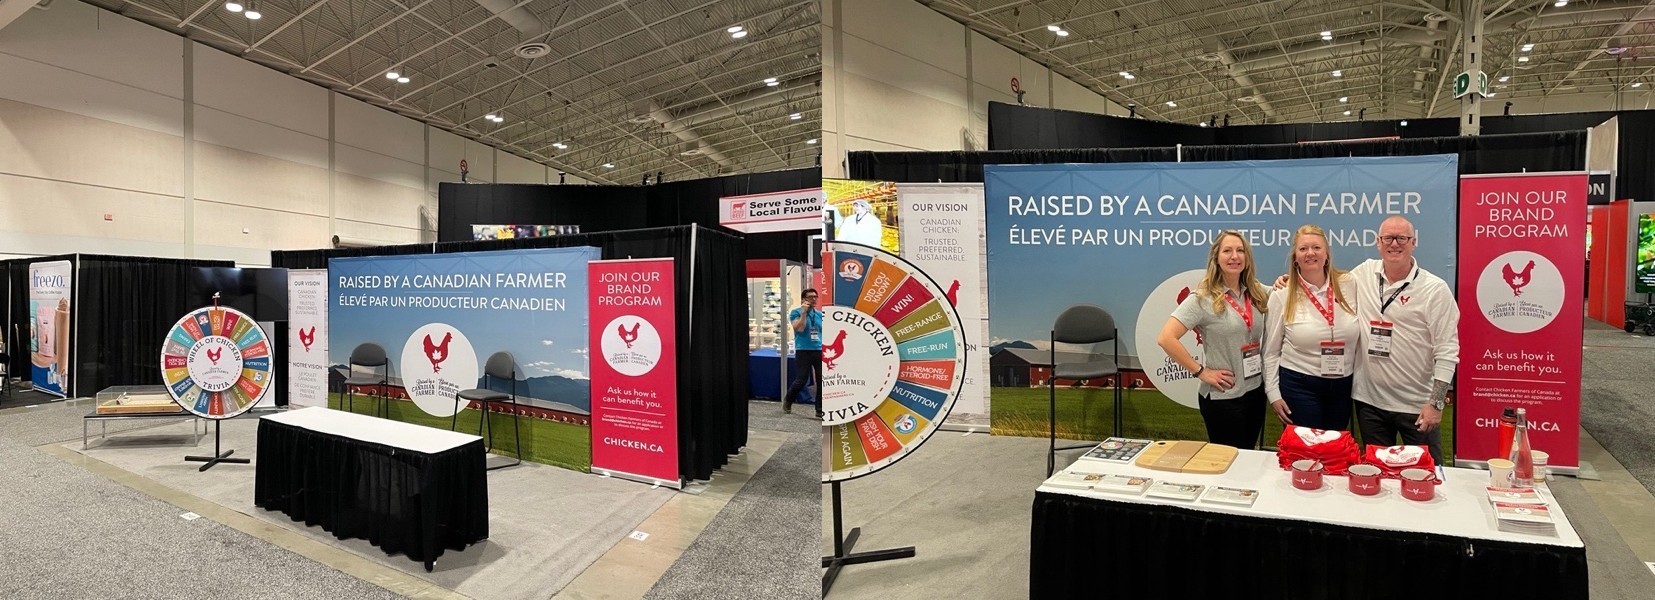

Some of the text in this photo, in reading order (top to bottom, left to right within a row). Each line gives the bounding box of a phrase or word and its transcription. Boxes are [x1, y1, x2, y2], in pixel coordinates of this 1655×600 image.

[1458, 74, 1469, 96] D
[785, 197, 816, 206] Some
[1008, 192, 1422, 216] RAISED BY A CANADIAN FARMER
[1477, 191, 1566, 205] JOIN OUR
[750, 208, 779, 216] Local
[1490, 208, 1554, 221] BRAND
[1010, 224, 1290, 246] ÉLEVÉ PAR UN PRODUTEUR
[1476, 224, 1568, 237] PROGRAM
[340, 273, 566, 288] RAISED BY A CANADIAN FARMER
[599, 272, 659, 282] JOIN OUR
[608, 284, 651, 293] BRAND
[864, 272, 886, 302] DID YOU
[872, 278, 891, 303] KNOW?
[340, 293, 565, 311] ÉLEVÉ PAR UN PRODUCTEUR CANADIEN
[599, 296, 662, 305] PROGRAM
[891, 294, 914, 313] WIN!
[1489, 307, 1515, 315] CANADIAN
[1520, 307, 1552, 316] PRODUCTEUR
[895, 312, 942, 337] FREE-RANGE
[832, 311, 894, 356] CHICKEN
[189, 342, 204, 363] WHEEL
[216, 338, 240, 361] CHICKEN
[908, 343, 947, 354] FREE-RUN
[1483, 349, 1503, 359] Ask
[1521, 350, 1543, 360] how
[1547, 352, 1554, 361] it
[906, 366, 945, 374] HORMONE/
[1157, 365, 1187, 376] CANAD
[1497, 361, 1535, 372] benefit
[1539, 366, 1562, 376] you.
[901, 371, 948, 381] STEROID-FREE
[1165, 371, 1195, 382] FARME
[203, 381, 230, 390] TRIVIA
[439, 386, 460, 394] PRODUCT
[634, 389, 649, 397] how
[893, 386, 938, 409] NUTRITION
[618, 396, 644, 406] benefit
[1476, 418, 1560, 432] CHIN.CA
[861, 422, 881, 451] FAVE DISH
[867, 418, 888, 450] DISH YOUR
[604, 437, 663, 453] CHICKEN.CA
[842, 441, 852, 465] AGAIN
